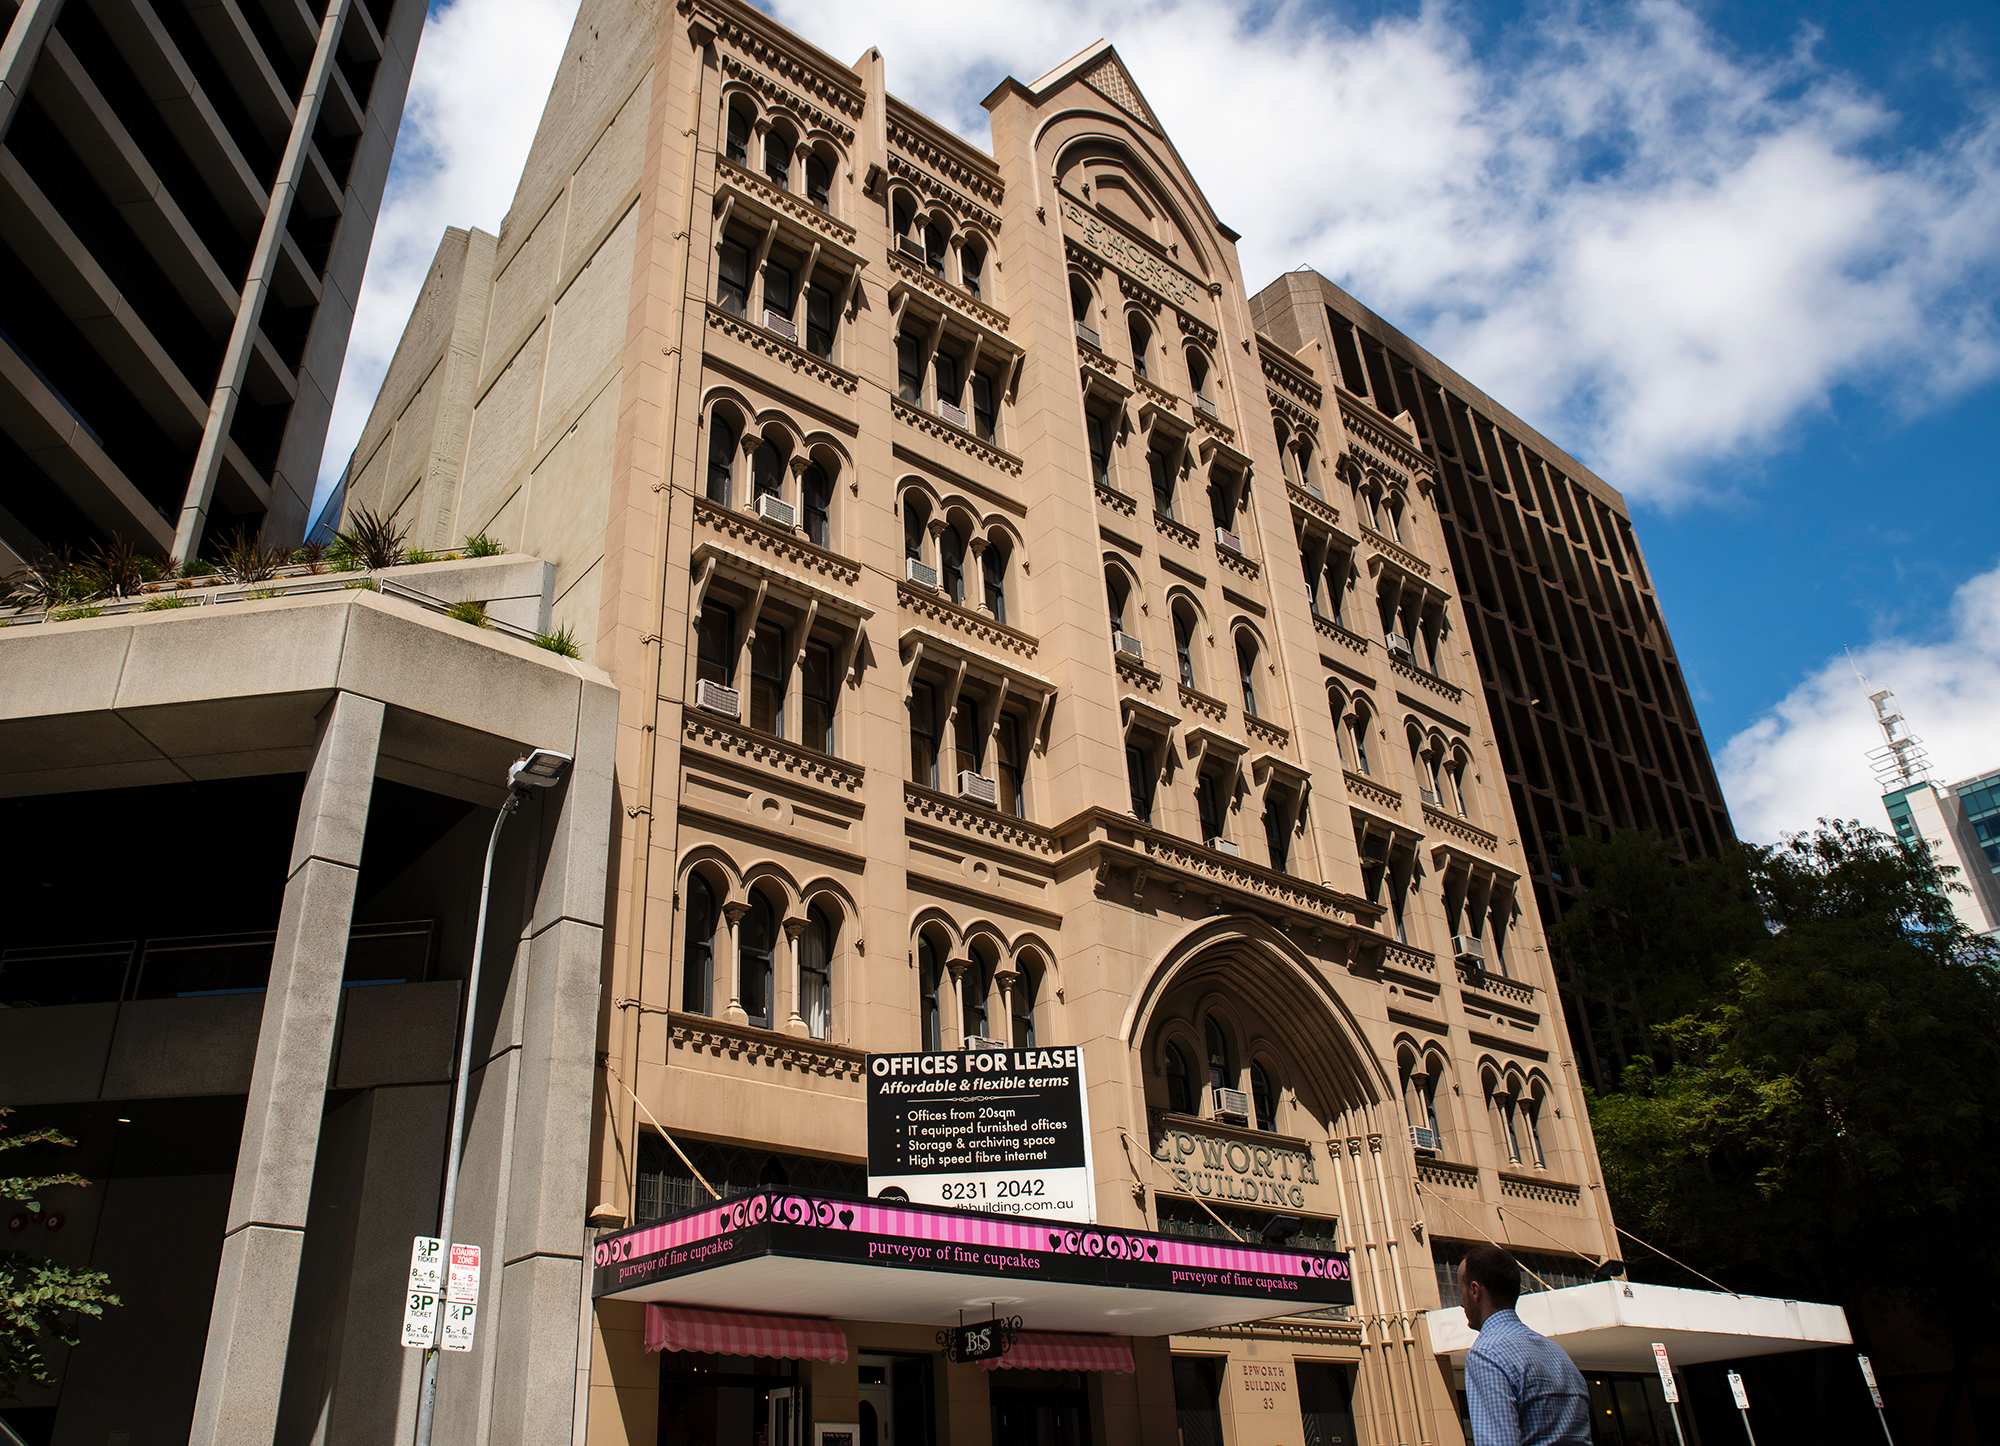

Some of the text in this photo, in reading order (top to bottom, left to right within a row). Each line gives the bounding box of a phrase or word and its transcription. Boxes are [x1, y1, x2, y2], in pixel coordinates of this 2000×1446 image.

[1065, 201, 1199, 303] EPWORTH
[872, 1049, 1077, 1077] OFFICES FOR LEASE
[880, 1076, 1070, 1095] Affordable & flexible terms
[907, 1107, 1016, 1122] Offices from 20sqm
[908, 1119, 1068, 1138] IT equipped furnished offices
[908, 1136, 1056, 1153] Storage & archiving space
[909, 1150, 1048, 1168] High speed fibre internet
[1151, 1129, 1319, 1185] EPWORTH
[941, 1179, 1045, 1200] 8231 2042
[1171, 1167, 1305, 1208] BUILDING
[452, 1247, 479, 1257] LOADING
[456, 1256, 475, 1264] ZONE
[619, 1238, 734, 1283] purveyor of fine cupcakes
[868, 1241, 1041, 1270] purveyor of fine cupcakes
[1172, 1270, 1299, 1293] purveyor of fine cupcakes
[410, 1294, 434, 1311] 3P
[411, 1310, 432, 1318] TICKET
[1243, 1365, 1285, 1377] EPWORTH
[1245, 1381, 1287, 1392] BUILDING
[1263, 1398, 1274, 1410] 33
